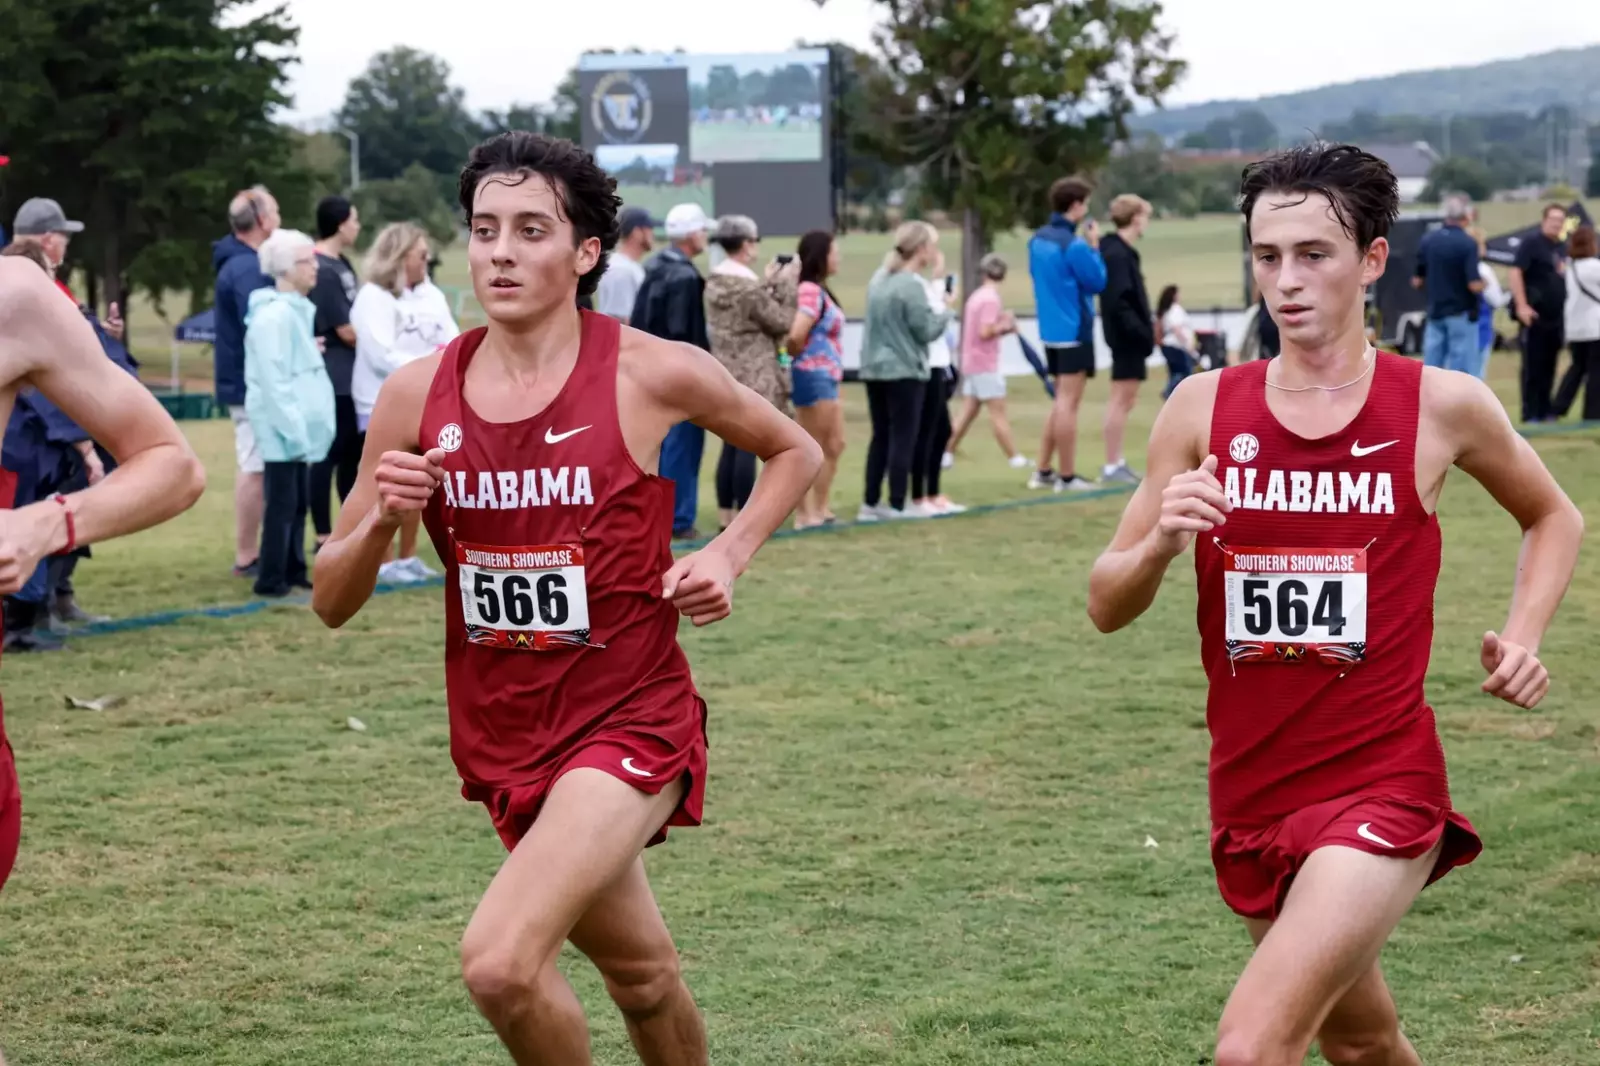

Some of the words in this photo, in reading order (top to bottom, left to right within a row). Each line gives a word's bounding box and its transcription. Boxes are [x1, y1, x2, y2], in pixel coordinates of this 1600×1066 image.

[439, 423, 462, 451] SEC
[1230, 433, 1259, 462] SEC
[445, 466, 594, 509] ALABAMA
[1225, 467, 1395, 513] ALABAMA
[465, 549, 510, 567] SOUTHERN
[512, 550, 572, 567] SHOWCASE
[1234, 554, 1288, 571] SOUTHERN
[1290, 555, 1354, 571] SHOWCASE
[473, 572, 569, 626] 566
[1243, 580, 1346, 636] 564
